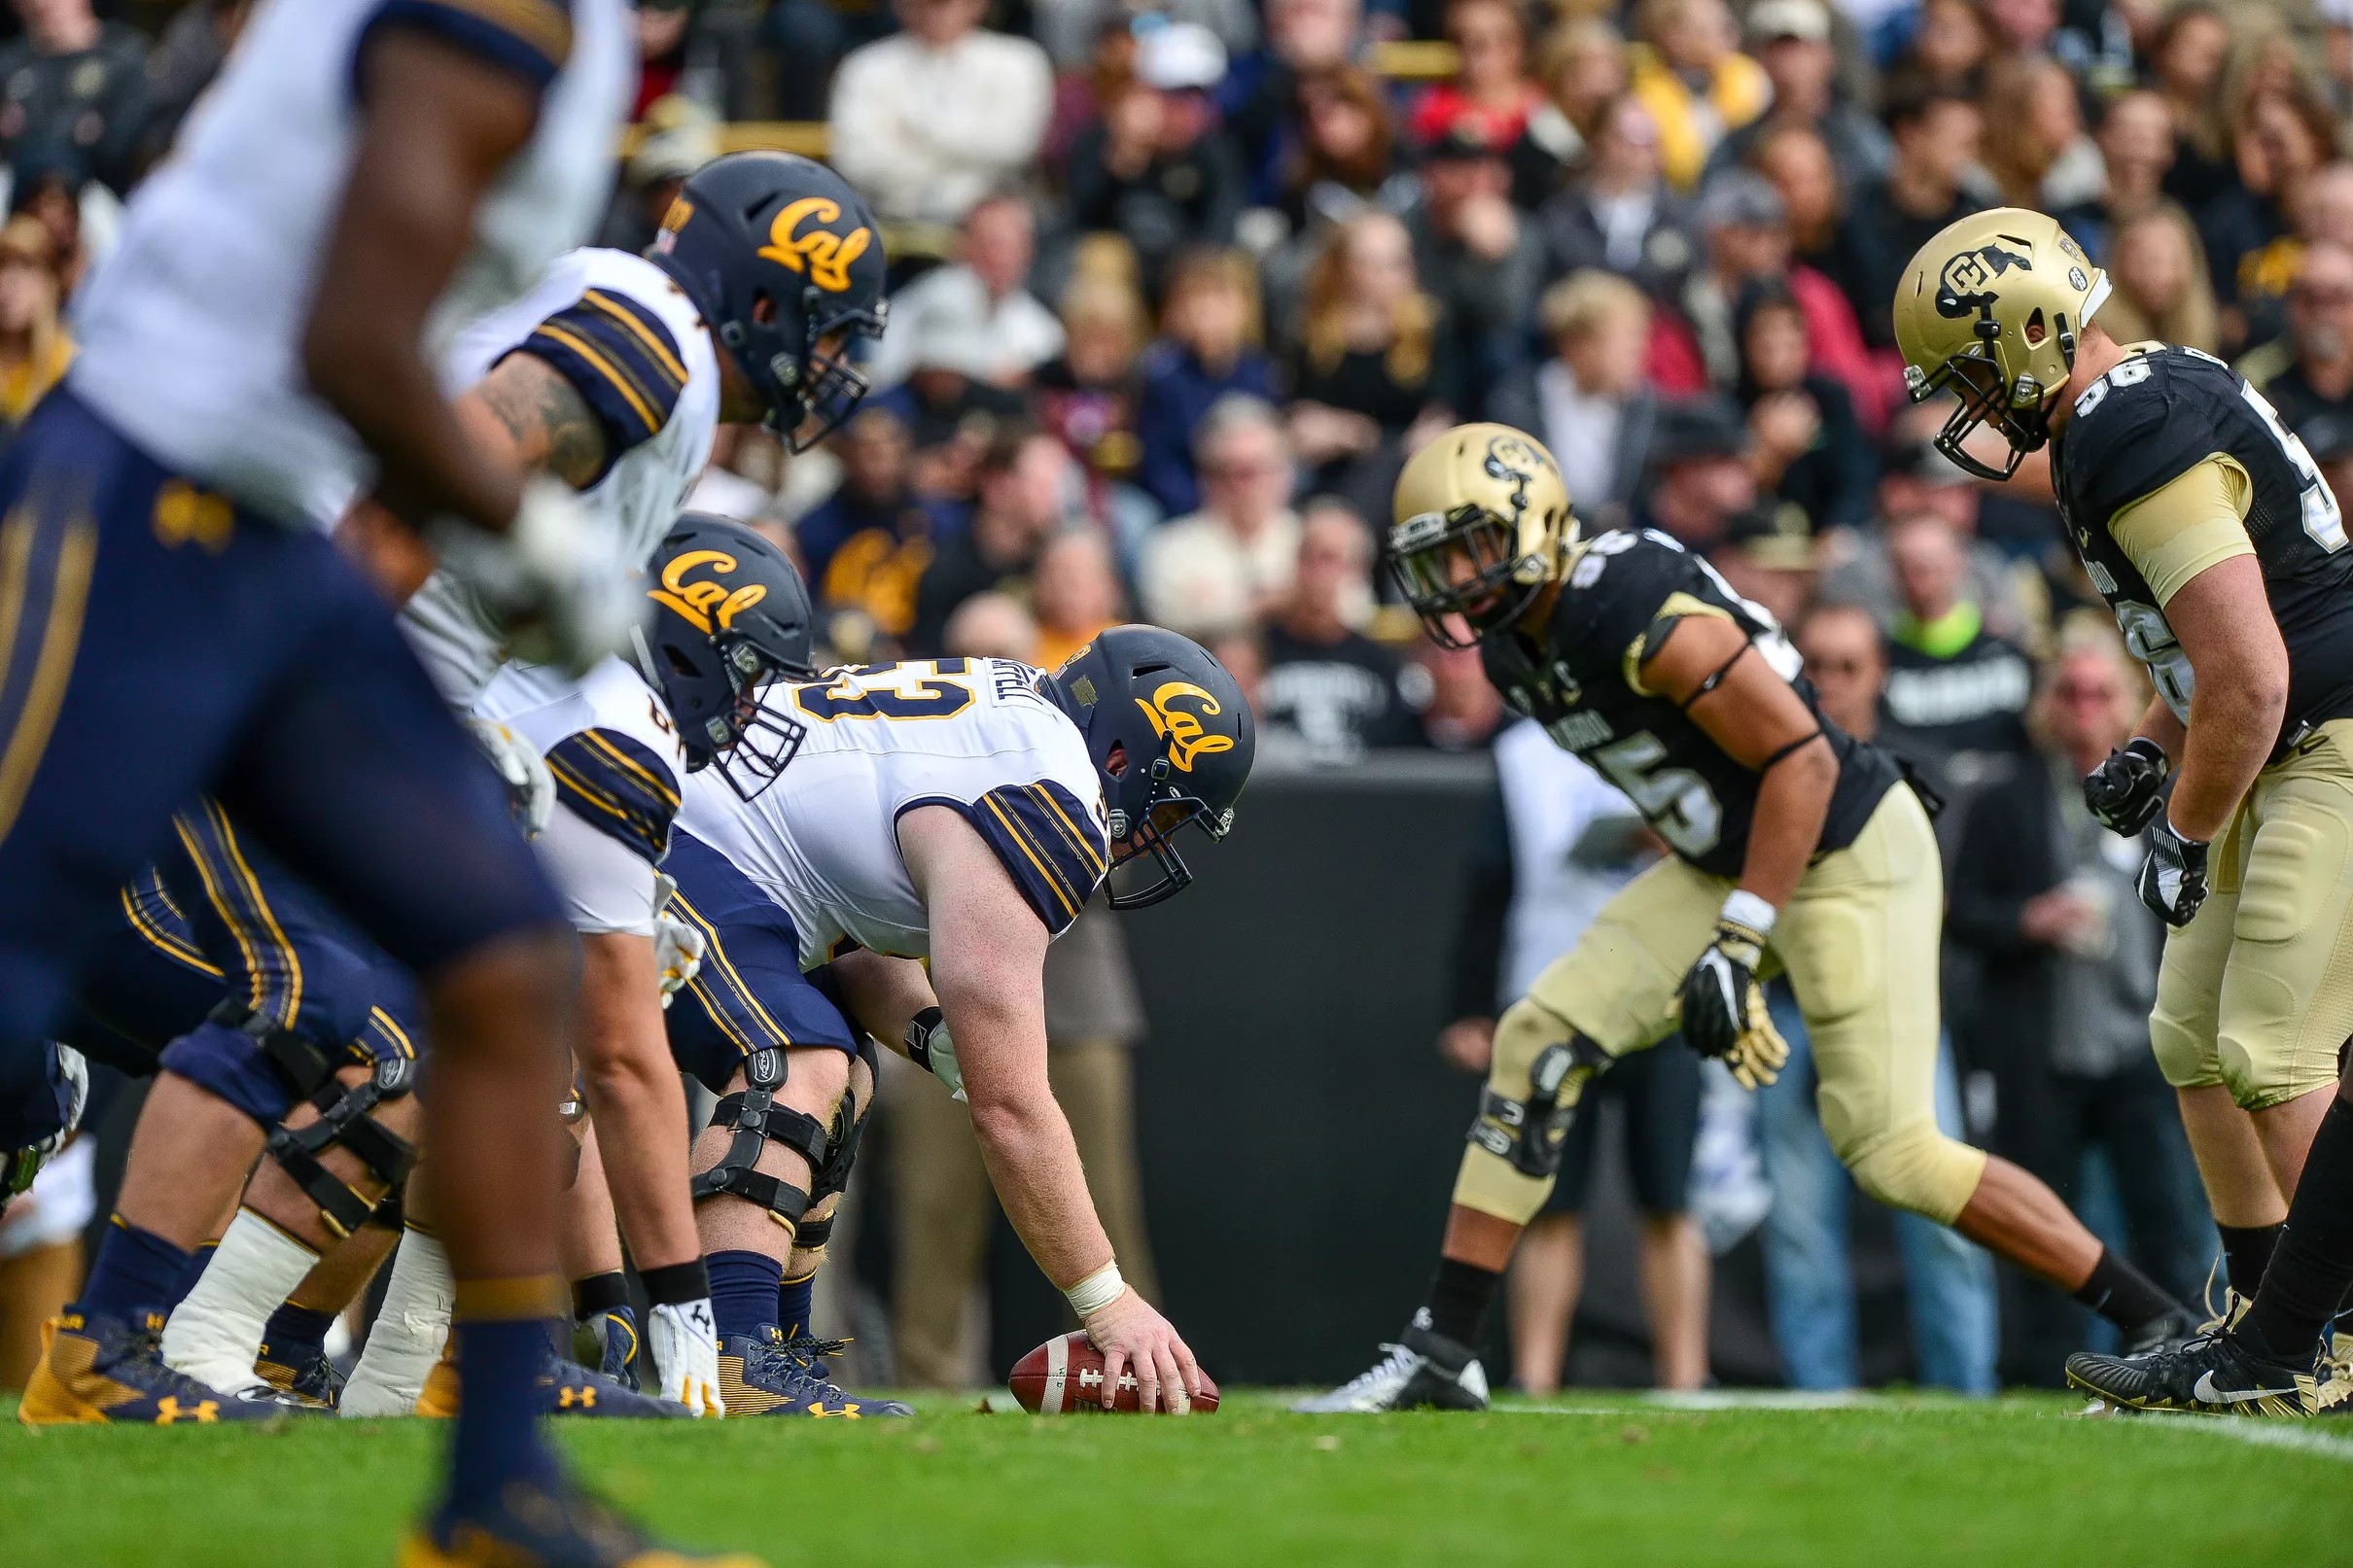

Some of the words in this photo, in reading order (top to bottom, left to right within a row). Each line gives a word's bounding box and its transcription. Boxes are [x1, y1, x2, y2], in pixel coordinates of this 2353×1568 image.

[756, 196, 872, 292] Cal
[646, 549, 767, 636] Cal
[1134, 681, 1235, 773] Cal
